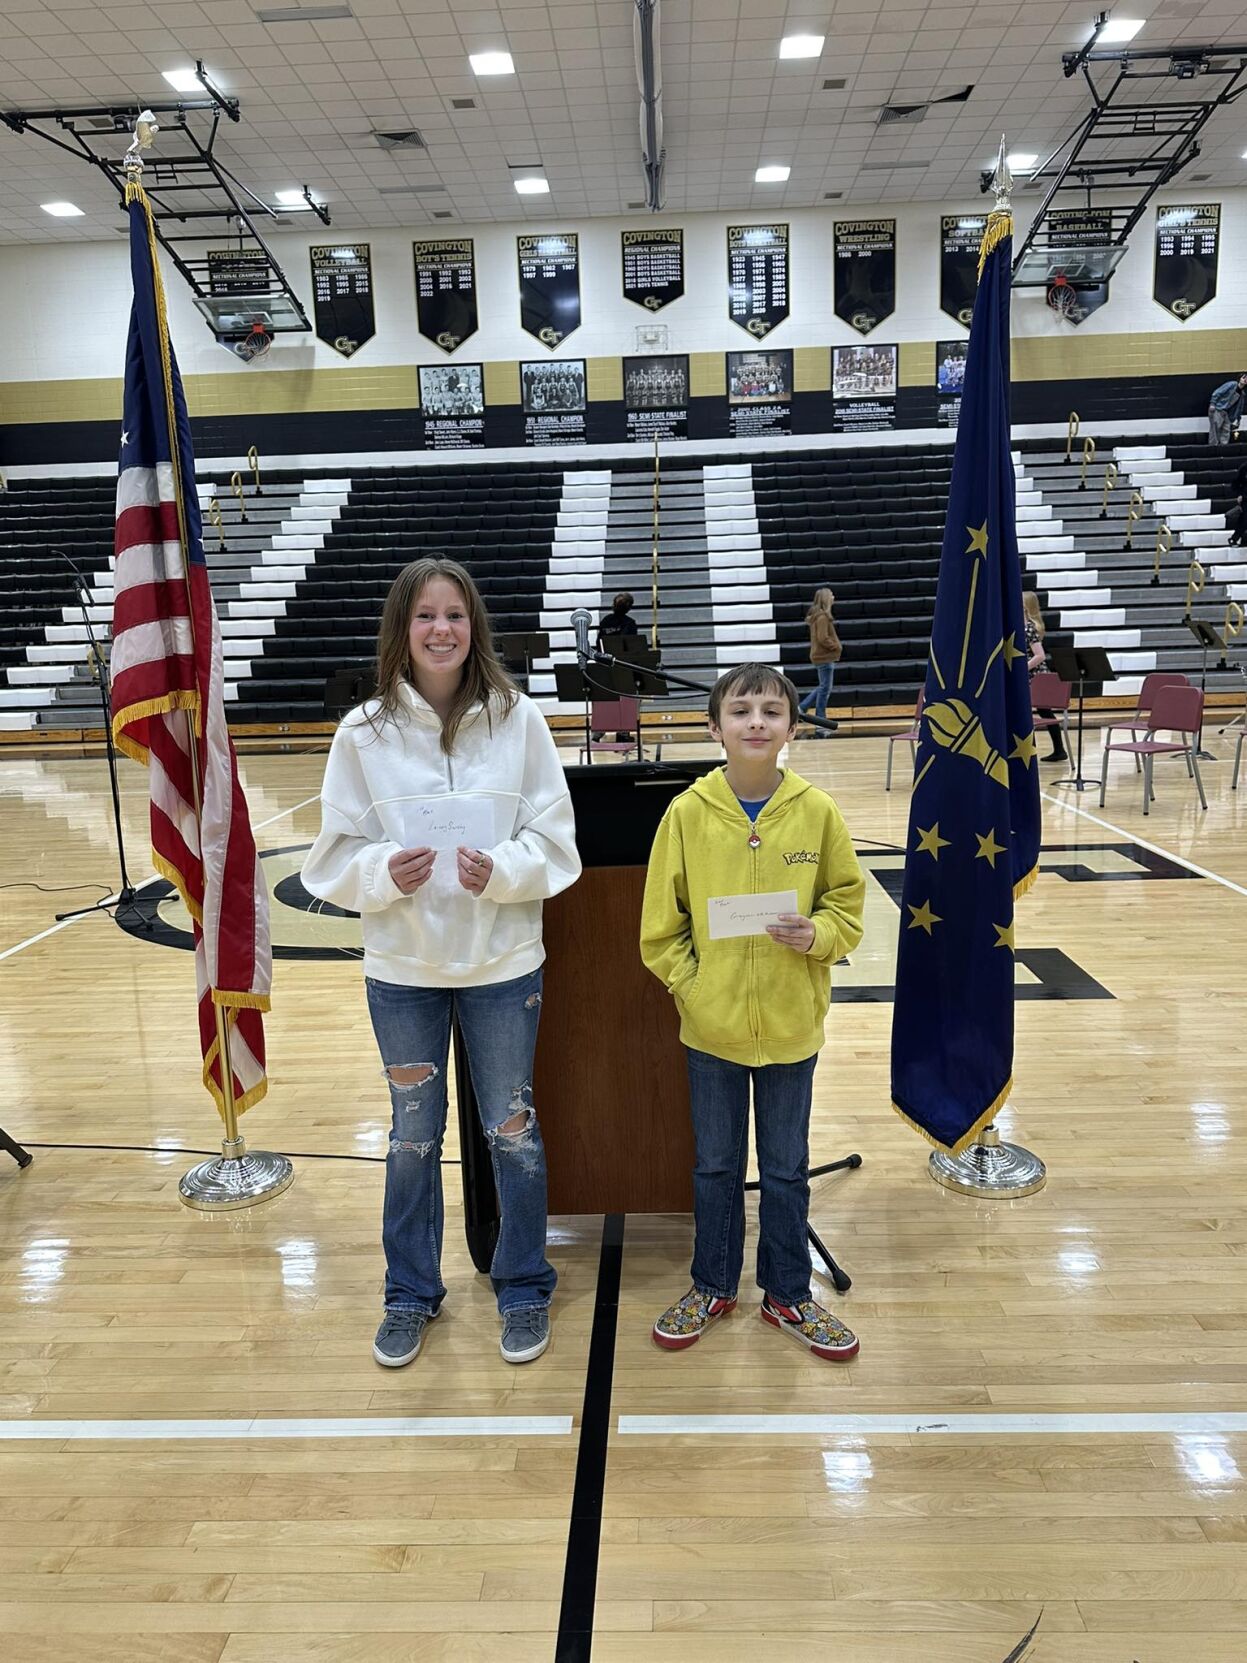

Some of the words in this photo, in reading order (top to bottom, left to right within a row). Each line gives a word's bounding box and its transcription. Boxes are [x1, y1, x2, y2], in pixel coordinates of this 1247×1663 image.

[943, 216, 988, 230] COVINGT
[1188, 218, 1218, 226] TENNIS
[835, 221, 894, 236] COVINGTON
[1056, 223, 1104, 232] BASEBALL
[623, 230, 682, 244] COVINGTON
[839, 234, 890, 242] WRESTLING
[948, 229, 984, 238] SOFTBA
[414, 240, 472, 255] COVINGTON
[311, 245, 368, 260] COVINGTON
[314, 258, 367, 267] VOLLEYBALL
[441, 254, 472, 262] TENNIS
